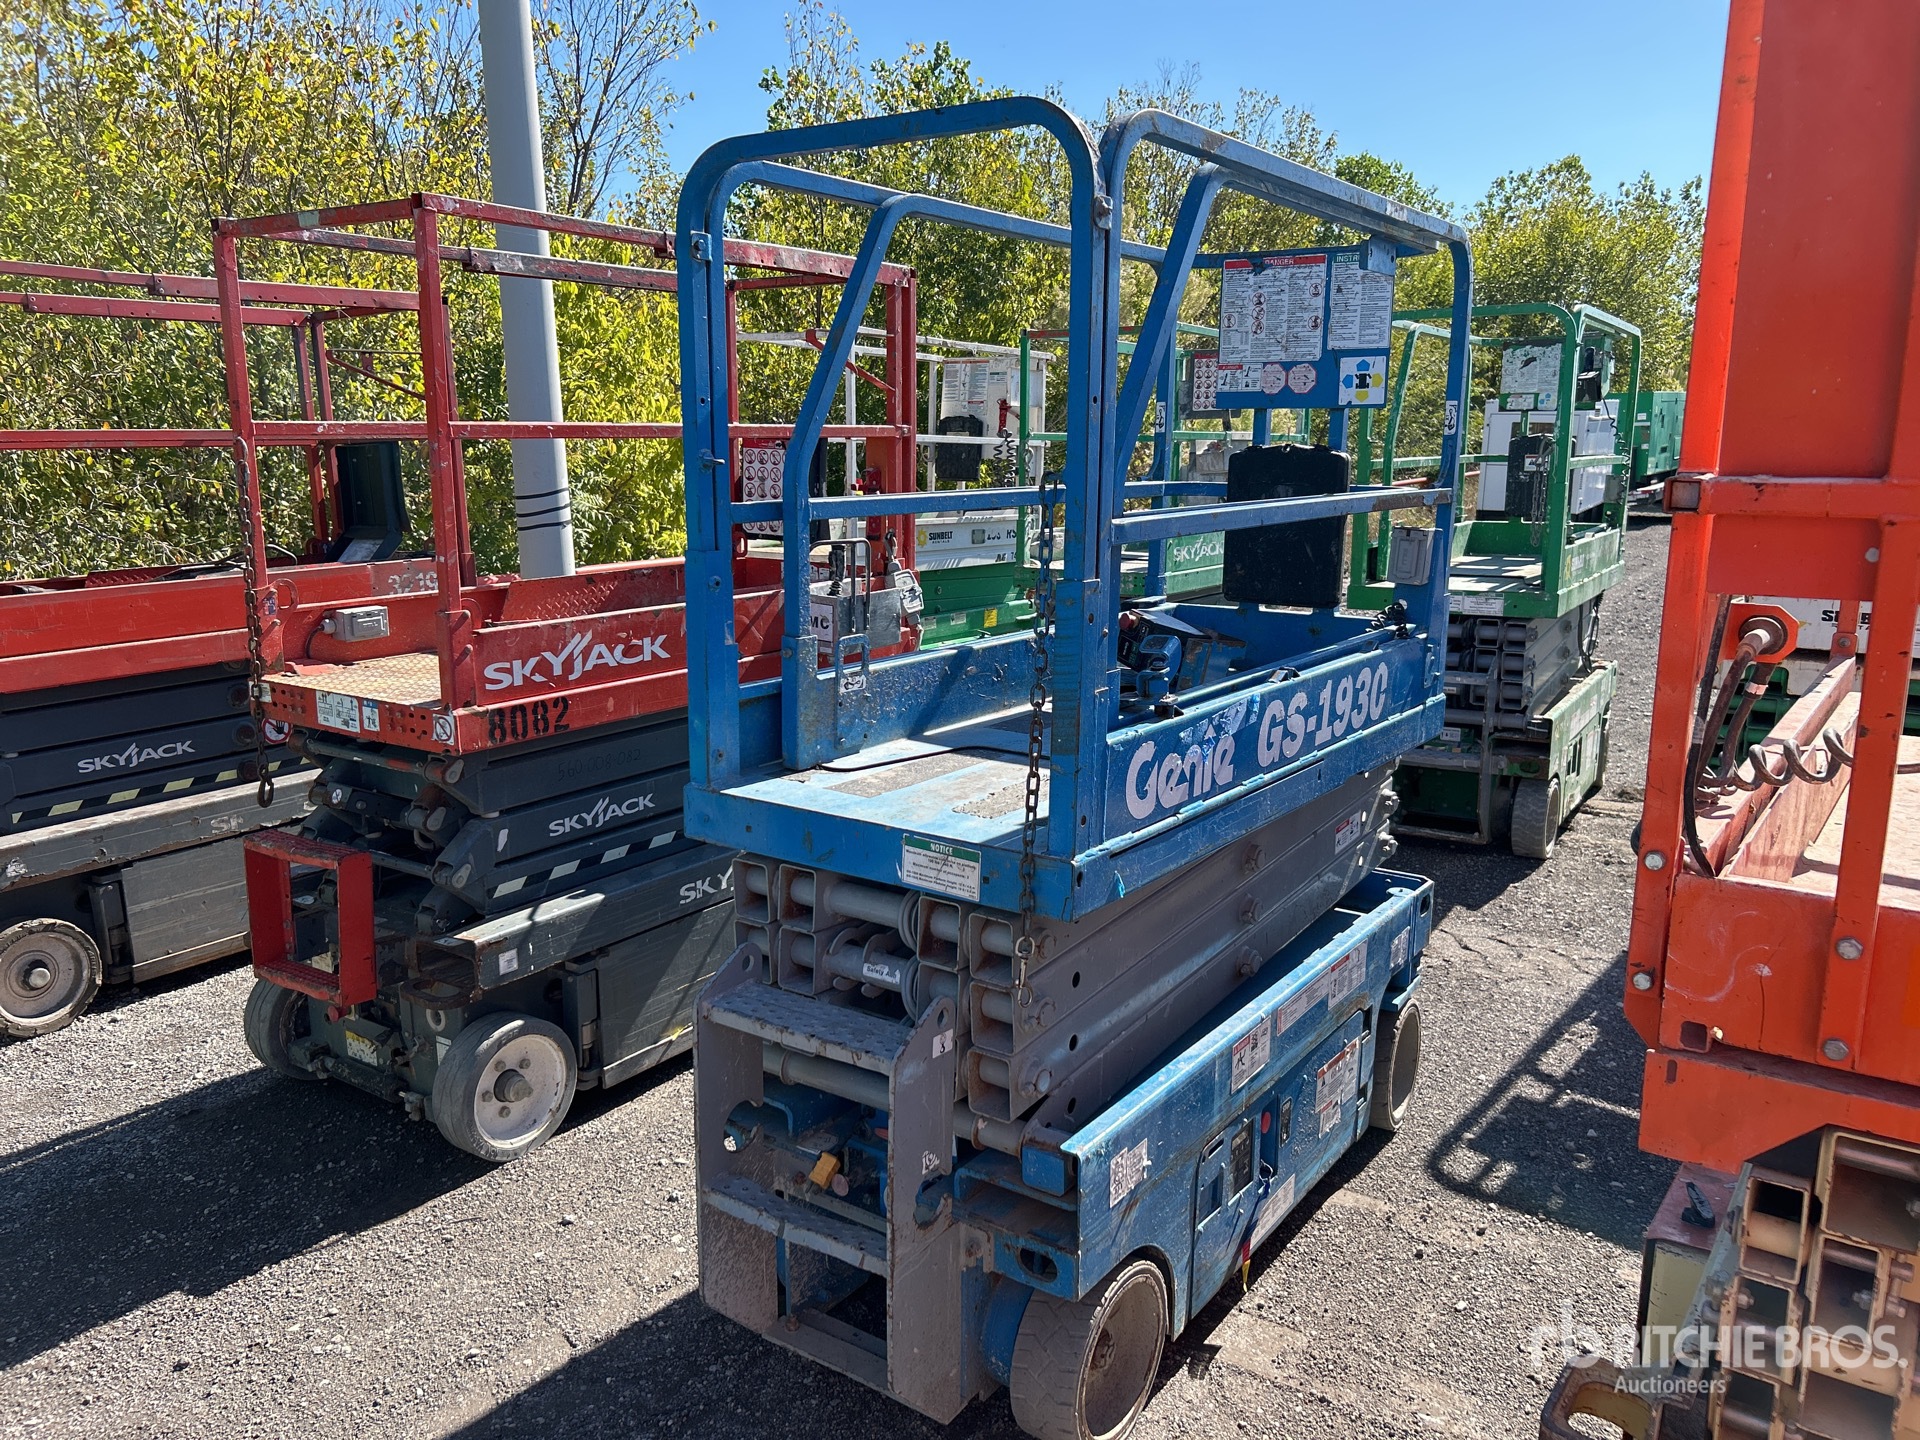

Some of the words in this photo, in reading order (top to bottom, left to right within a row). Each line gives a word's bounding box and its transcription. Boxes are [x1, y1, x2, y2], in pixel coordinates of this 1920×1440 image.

[928, 531, 953, 541] SUNBELT
[483, 629, 671, 691] SKYJACK
[488, 697, 571, 744] 8082
[77, 740, 196, 774] SKYJACK
[1126, 723, 1236, 820] Genie
[548, 793, 656, 837] SKYJACK
[930, 842, 954, 856] NOTICE
